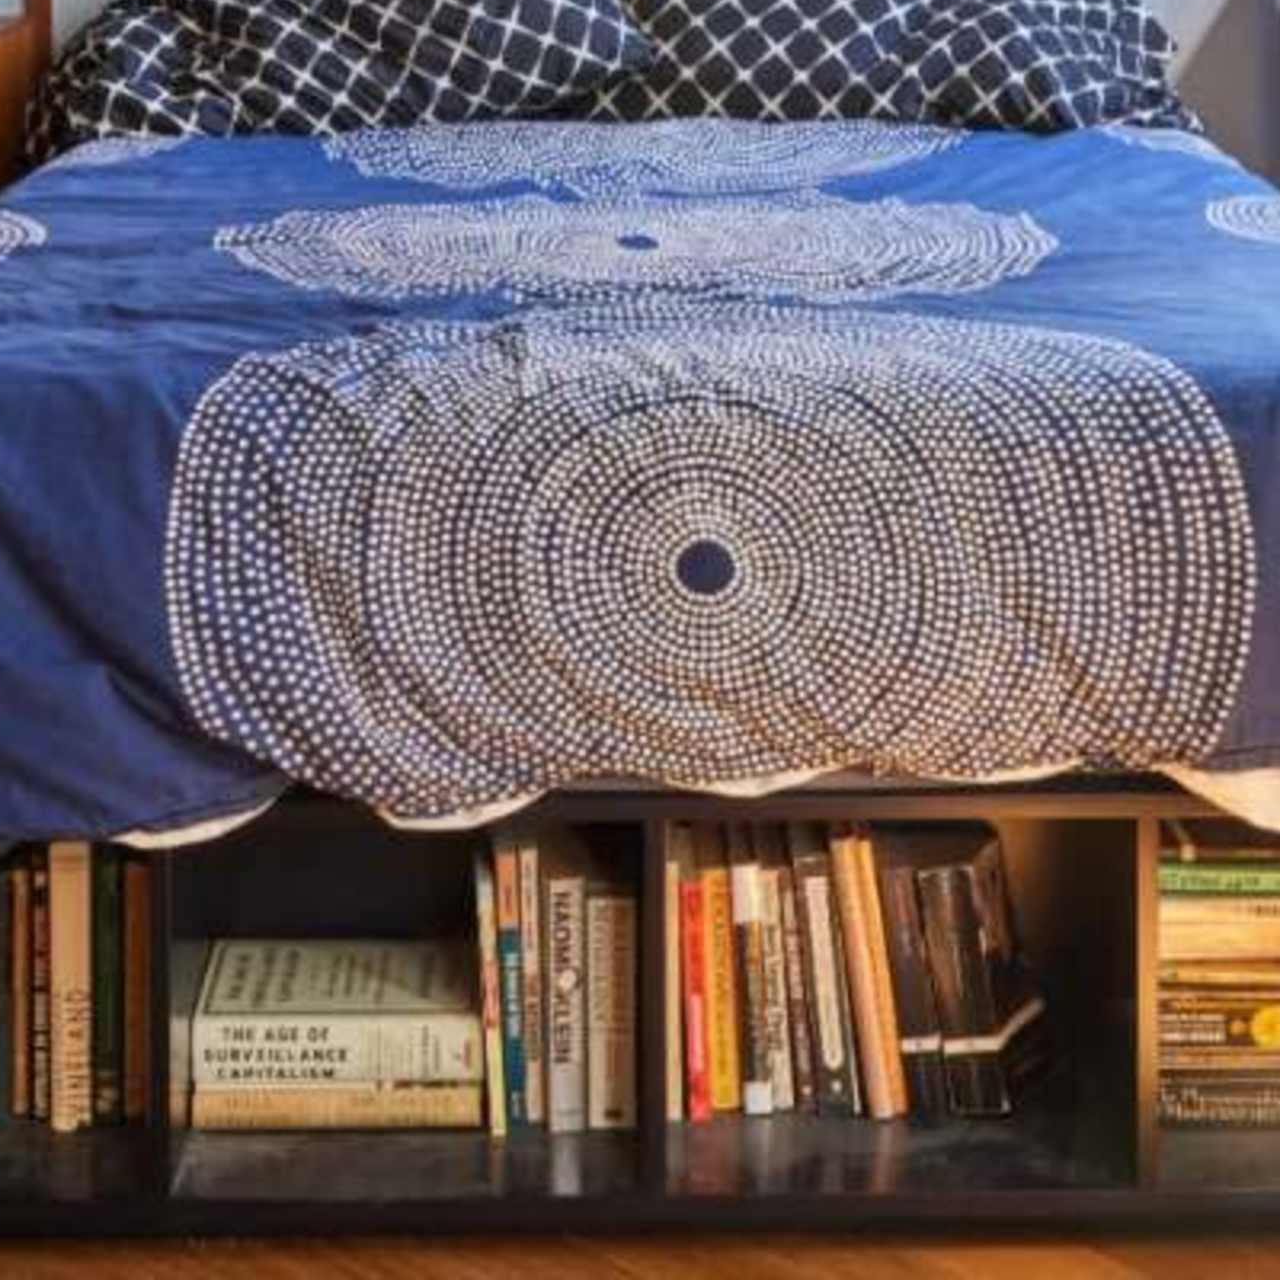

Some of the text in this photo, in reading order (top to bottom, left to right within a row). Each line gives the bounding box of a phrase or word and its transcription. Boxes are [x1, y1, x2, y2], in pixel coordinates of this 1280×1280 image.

[553, 891, 571, 971] NAOMI
[222, 1027, 331, 1042] THE AGE OF
[204, 1049, 348, 1063] SURVEILLANCE
[216, 1068, 335, 1080] CAPITALISM
